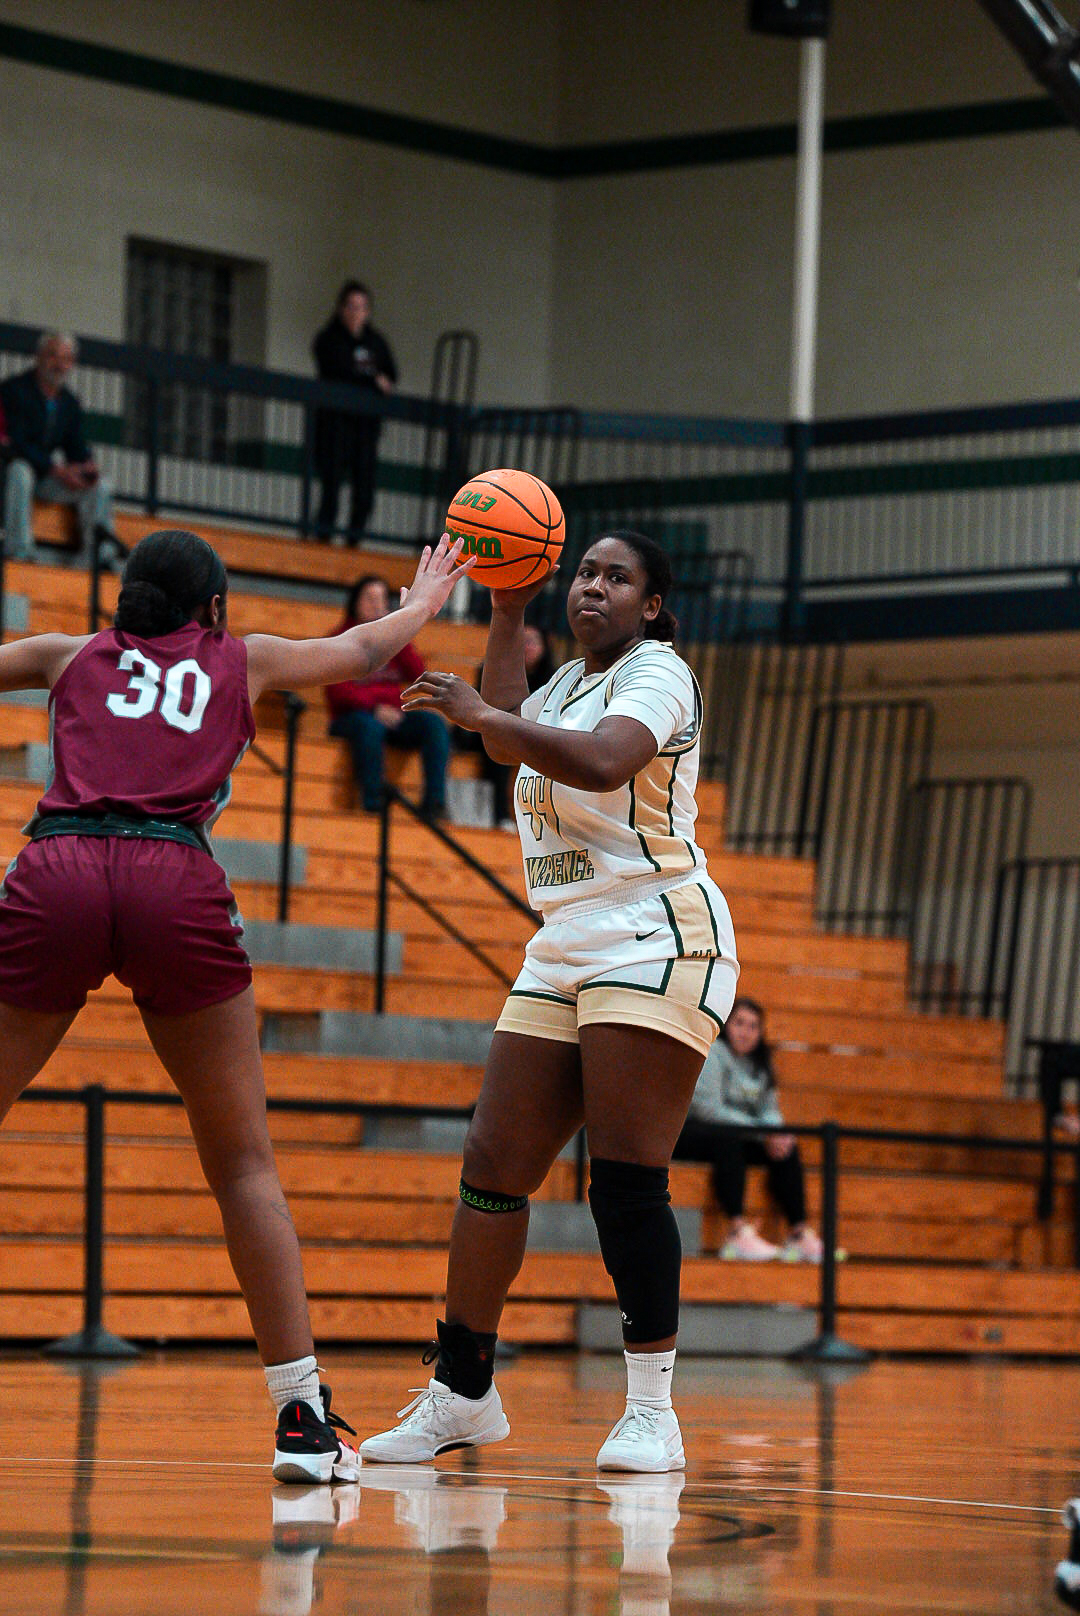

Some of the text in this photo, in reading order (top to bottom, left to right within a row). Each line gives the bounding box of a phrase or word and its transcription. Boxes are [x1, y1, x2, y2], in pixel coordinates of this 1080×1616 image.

[105, 648, 212, 734] 30
[517, 775, 562, 842] 44
[524, 848, 594, 889] WRENCE
